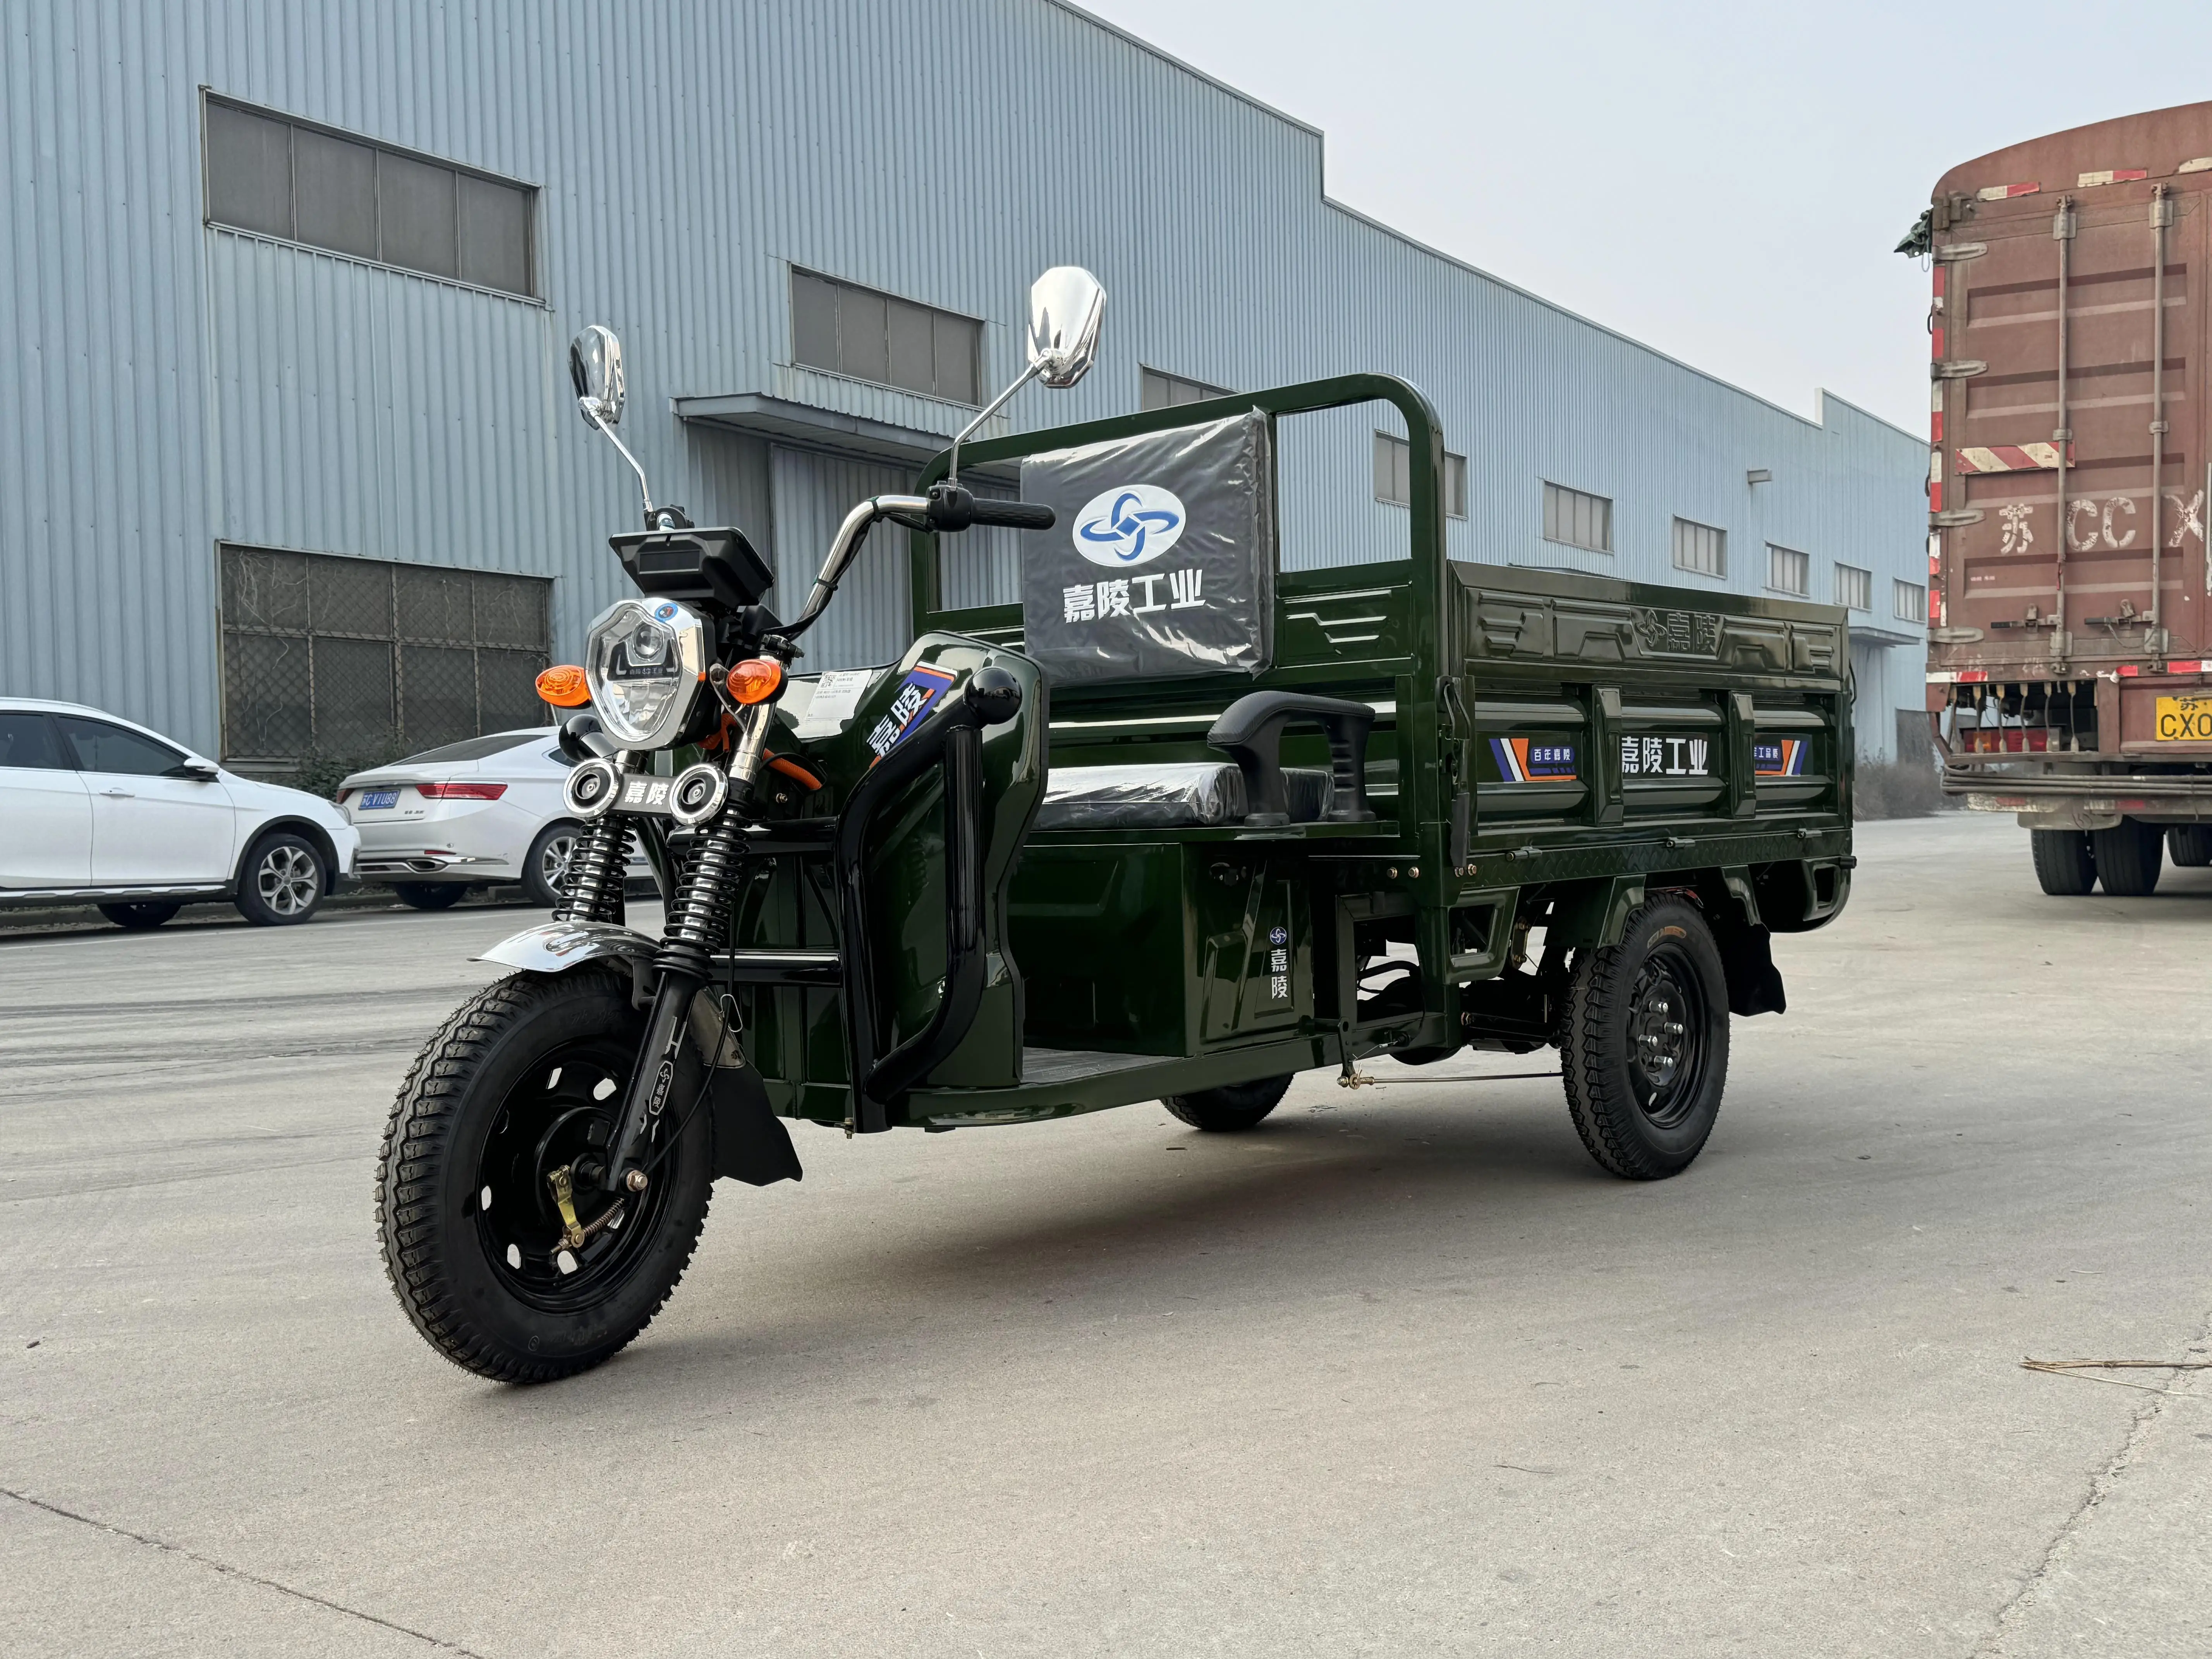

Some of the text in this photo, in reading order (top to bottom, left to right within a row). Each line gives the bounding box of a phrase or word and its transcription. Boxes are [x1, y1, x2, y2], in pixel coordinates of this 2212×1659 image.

[1063, 568, 1206, 623] 嘉陵工业
[1667, 611, 1716, 654] 嘉陵
[866, 682, 928, 757] 嘉陵
[2179, 698, 2198, 711] 苏
[1534, 749, 1570, 761] 百年嘉陵
[1621, 736, 1708, 775] 嘉陵工业
[625, 781, 669, 805] 嘉陵
[1271, 948, 1288, 999] 嘉陵
